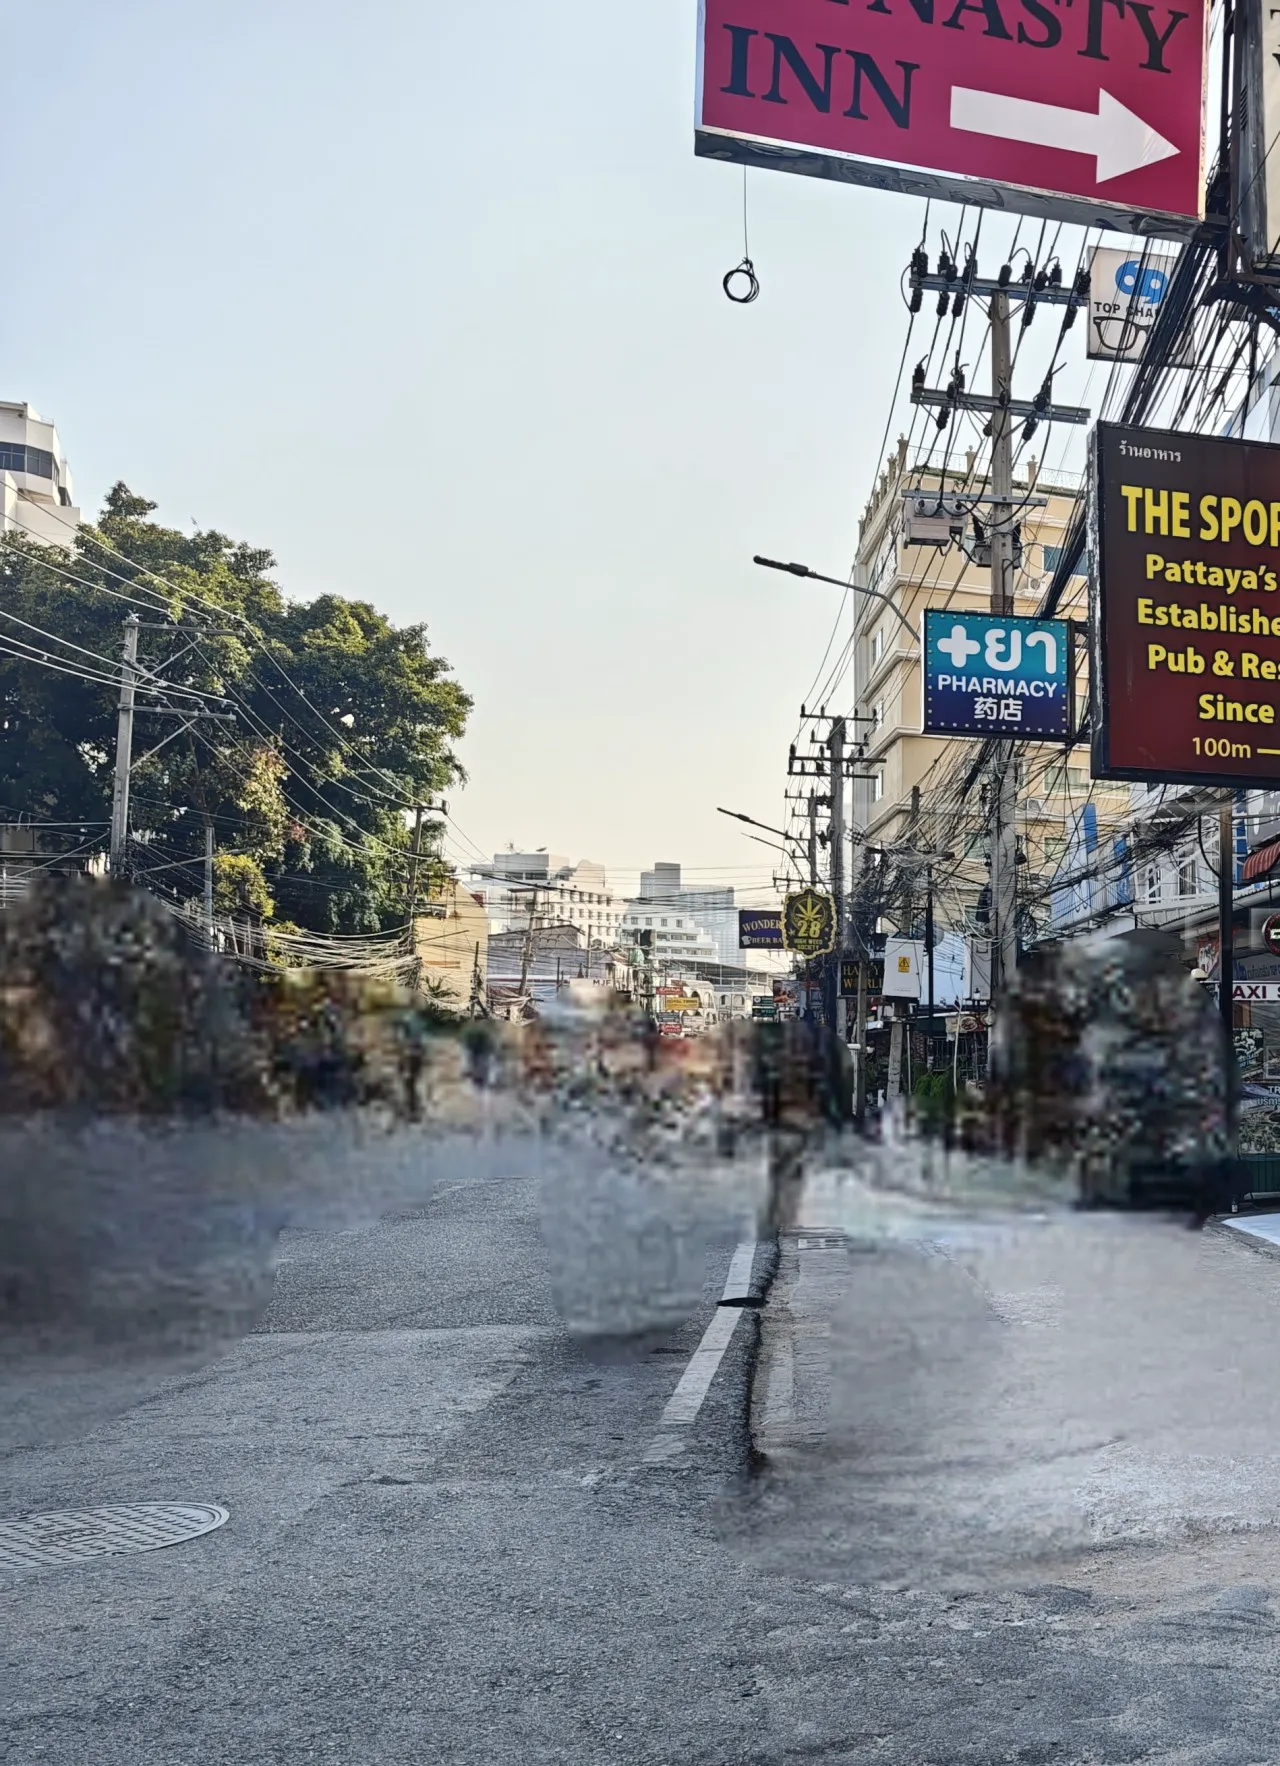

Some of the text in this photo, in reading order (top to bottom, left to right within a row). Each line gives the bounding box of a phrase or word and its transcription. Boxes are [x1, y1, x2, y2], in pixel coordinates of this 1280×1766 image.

[720, 24, 920, 130] INN
[1094, 301, 1121, 314] TOP
[1118, 440, 1182, 463] ร้านอาหาร
[1121, 485, 1190, 538] THE
[1146, 553, 1277, 595] Pattaya's
[984, 628, 1057, 675] ยา
[1148, 643, 1206, 677] Pub
[1211, 650, 1234, 679] &
[937, 674, 1058, 699] PHARMACY
[973, 696, 1023, 722] 药店
[1198, 693, 1276, 725] Since
[1192, 736, 1252, 759] 100m
[797, 920, 821, 938] 28
[1233, 985, 1267, 999] AXI
[1268, 1085, 1280, 1095] TR
